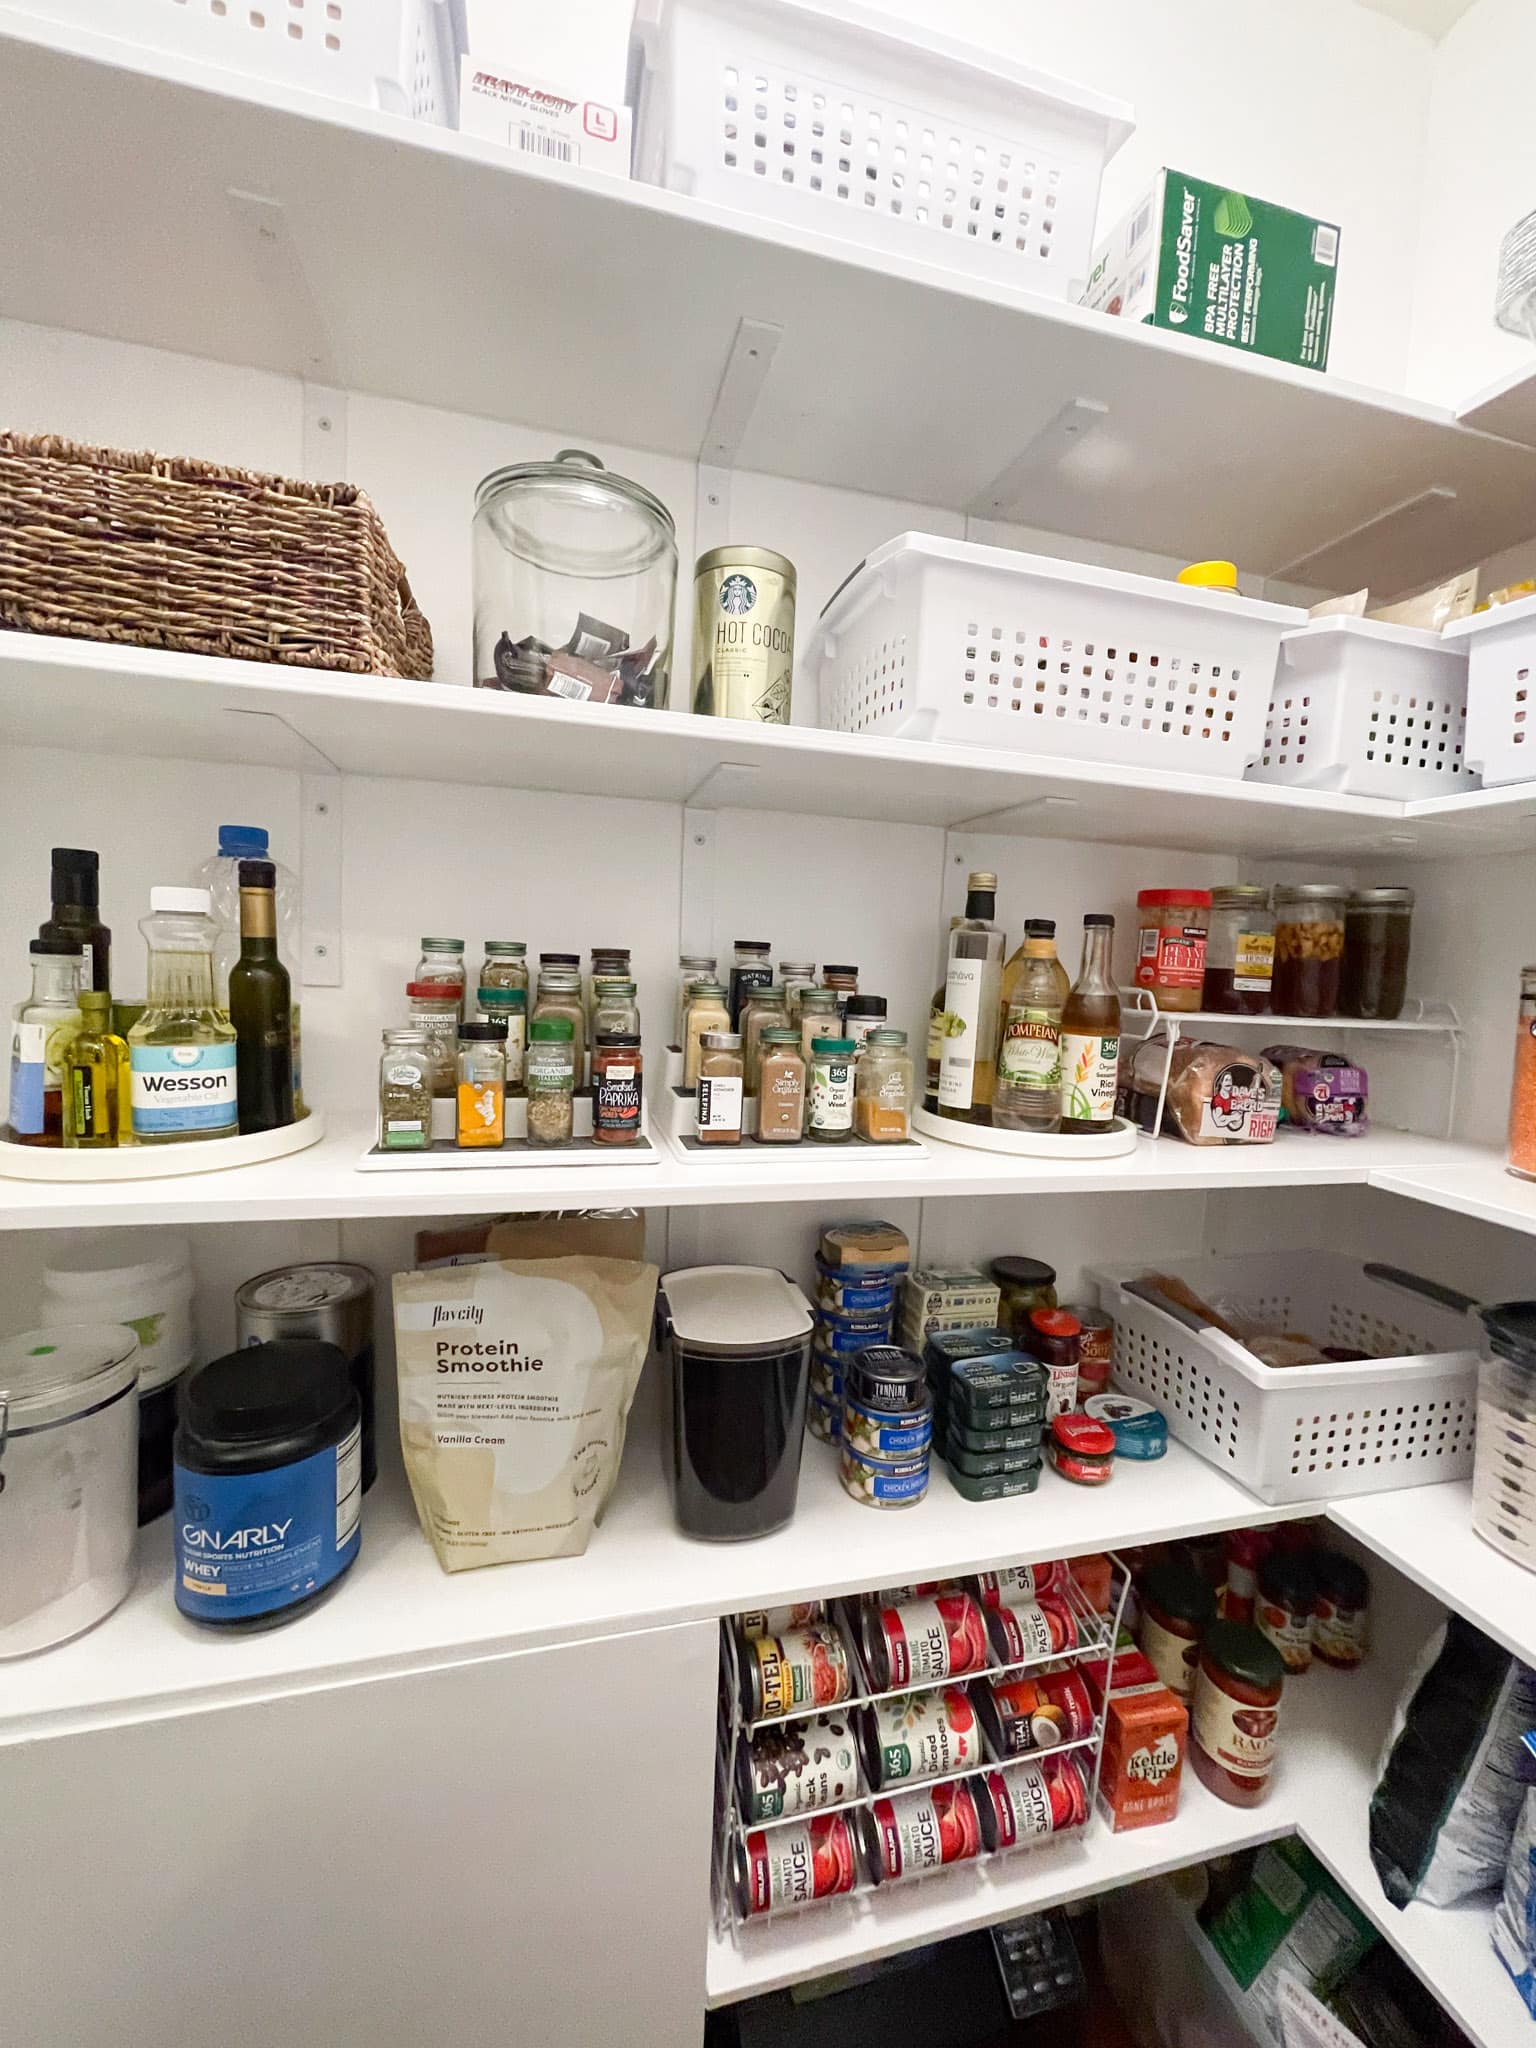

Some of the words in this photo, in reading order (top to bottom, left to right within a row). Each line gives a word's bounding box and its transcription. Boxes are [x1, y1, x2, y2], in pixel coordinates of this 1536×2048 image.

[472, 71, 578, 113] HEAVY-DUTY
[472, 85, 498, 99] BLACK
[530, 102, 560, 118] GLOVES
[595, 112, 606, 126] L
[1173, 190, 1197, 302] FoodSaver
[1207, 262, 1220, 300] FREE
[1215, 244, 1233, 336] MULTILAYER
[1226, 242, 1244, 339] PROTECTION
[1240, 313, 1251, 343] BEST
[1246, 238, 1258, 311] PERFORMING
[1204, 301, 1216, 333] BPA
[716, 621, 748, 645] HOT
[752, 622, 793, 654] COCOA
[740, 972, 771, 982] WATKINS
[1008, 1023, 1058, 1040] POMPEIAN
[143, 1075, 227, 1092] Wesson
[606, 1081, 637, 1092] Smoked
[775, 1079, 801, 1088] Simply
[831, 1069, 847, 1077] 365
[599, 1087, 639, 1107] PAPRIKA
[701, 1083, 710, 1122] SELEFINA
[1230, 1099, 1263, 1113] BREAD
[1231, 1085, 1266, 1099] DAVE'S
[432, 1304, 484, 1328] flavcity
[436, 1340, 519, 1357] Protein
[436, 1357, 544, 1374] Smoothie
[518, 1404, 560, 1413] INGREDIENTS
[437, 1434, 472, 1445] Vanilla
[474, 1435, 506, 1445] Cream
[182, 1517, 294, 1551] GNARLY
[184, 1557, 221, 1577] WHEY
[203, 1551, 234, 1561] SPORTS
[235, 1543, 285, 1560] NUTRITION
[1031, 1613, 1048, 1653] PASTE
[919, 1641, 932, 1675] TOMATO
[927, 1626, 944, 1679] SAUCE
[1014, 1720, 1026, 1751] THAI
[888, 1748, 902, 1777] 365
[926, 1734, 938, 1773] Diced
[1130, 1750, 1176, 1770] Kettle
[1021, 1791, 1035, 1827] TOMATO
[1025, 1776, 1048, 1833] SAUCE
[1122, 1800, 1144, 1814] BONE
[911, 1825, 923, 1864] TOMATO
[917, 1809, 936, 1868] SAUCE
[791, 1841, 808, 1902] SAUCE
